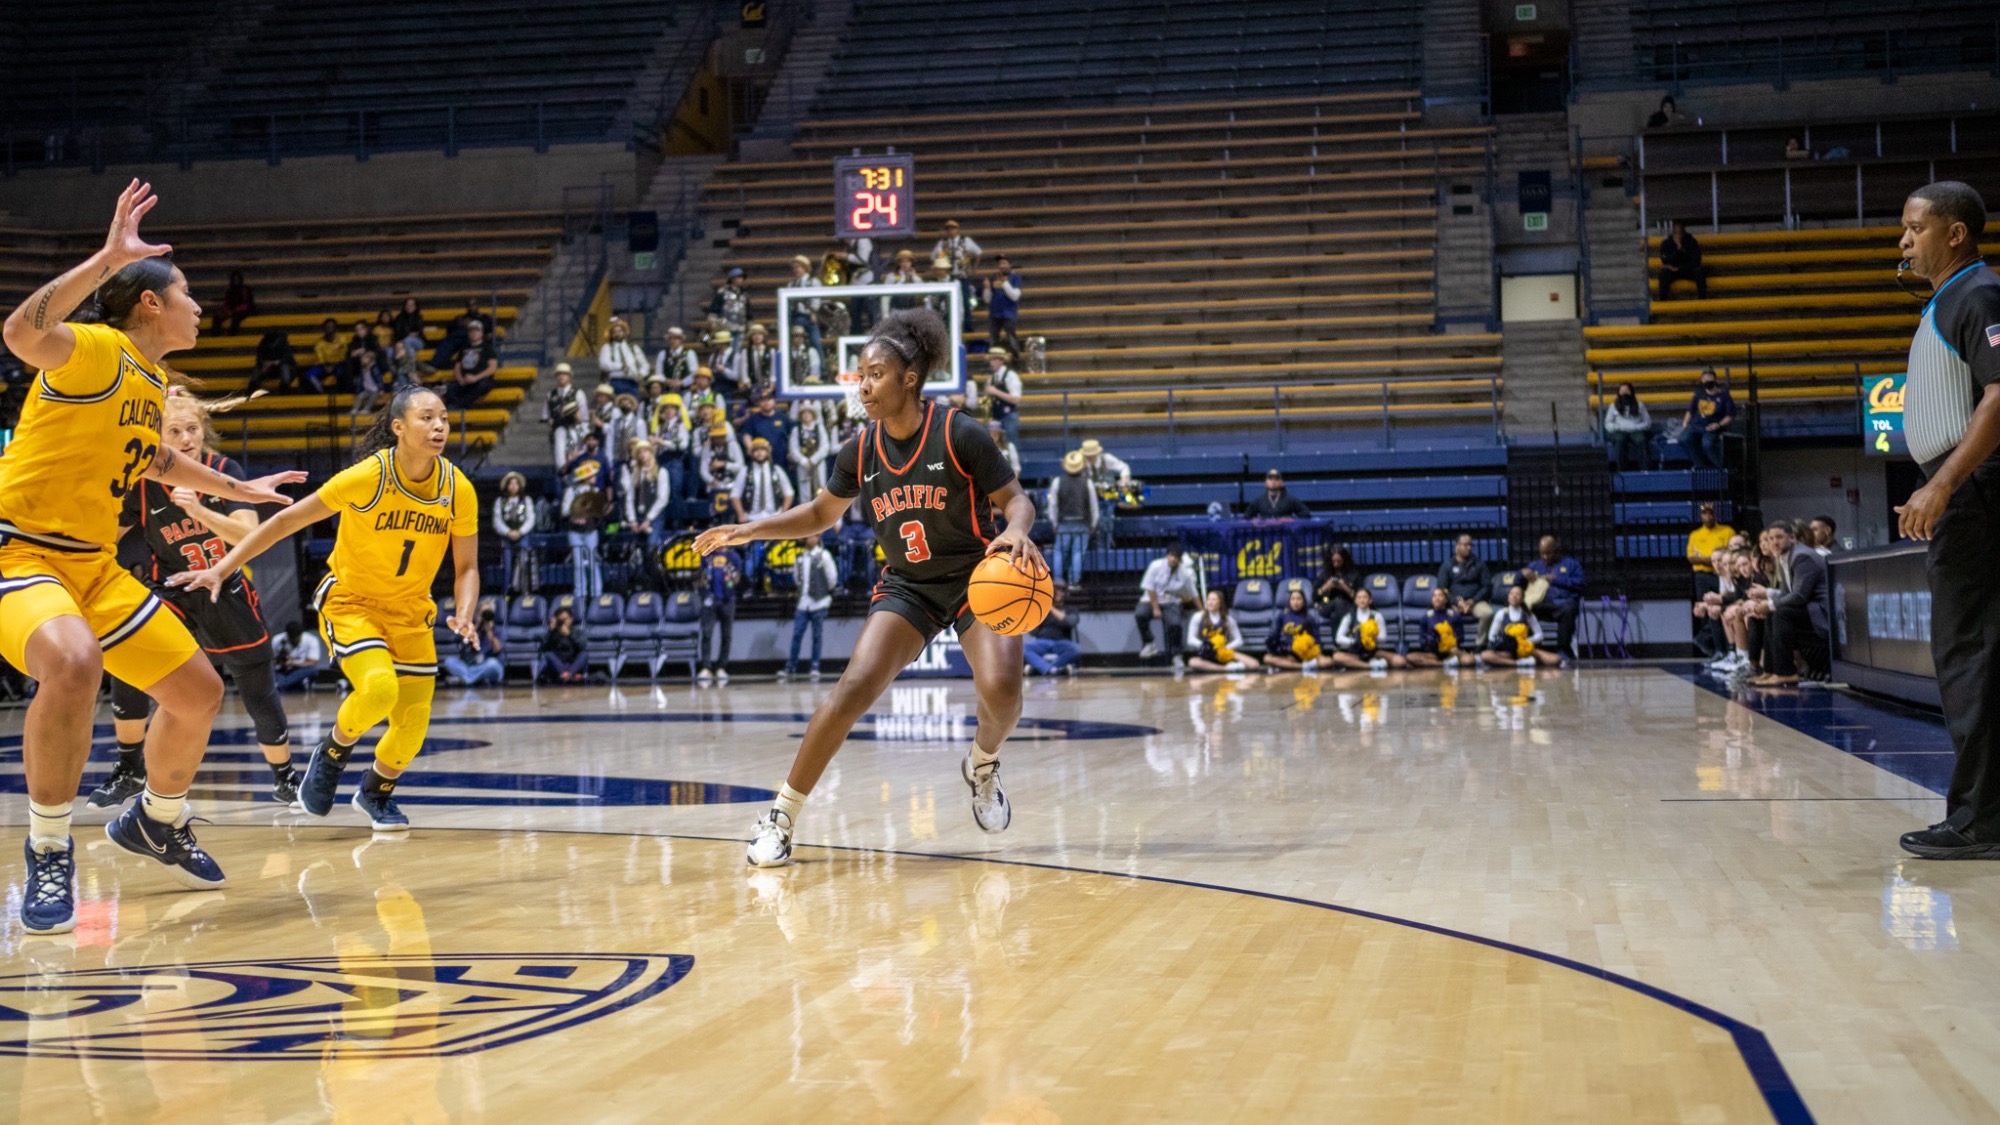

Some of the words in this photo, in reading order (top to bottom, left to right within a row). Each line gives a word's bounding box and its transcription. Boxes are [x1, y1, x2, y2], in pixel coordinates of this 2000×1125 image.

[859, 167, 903, 190] 7:31
[852, 192, 897, 230] 24
[1872, 419, 1893, 431] TOL
[375, 509, 449, 535] CALIFORNIA
[871, 484, 948, 522] PACIFIC
[180, 536, 228, 571] 33
[395, 539, 416, 577] 1
[899, 519, 932, 563] 3
[1237, 539, 1282, 578] Cal
